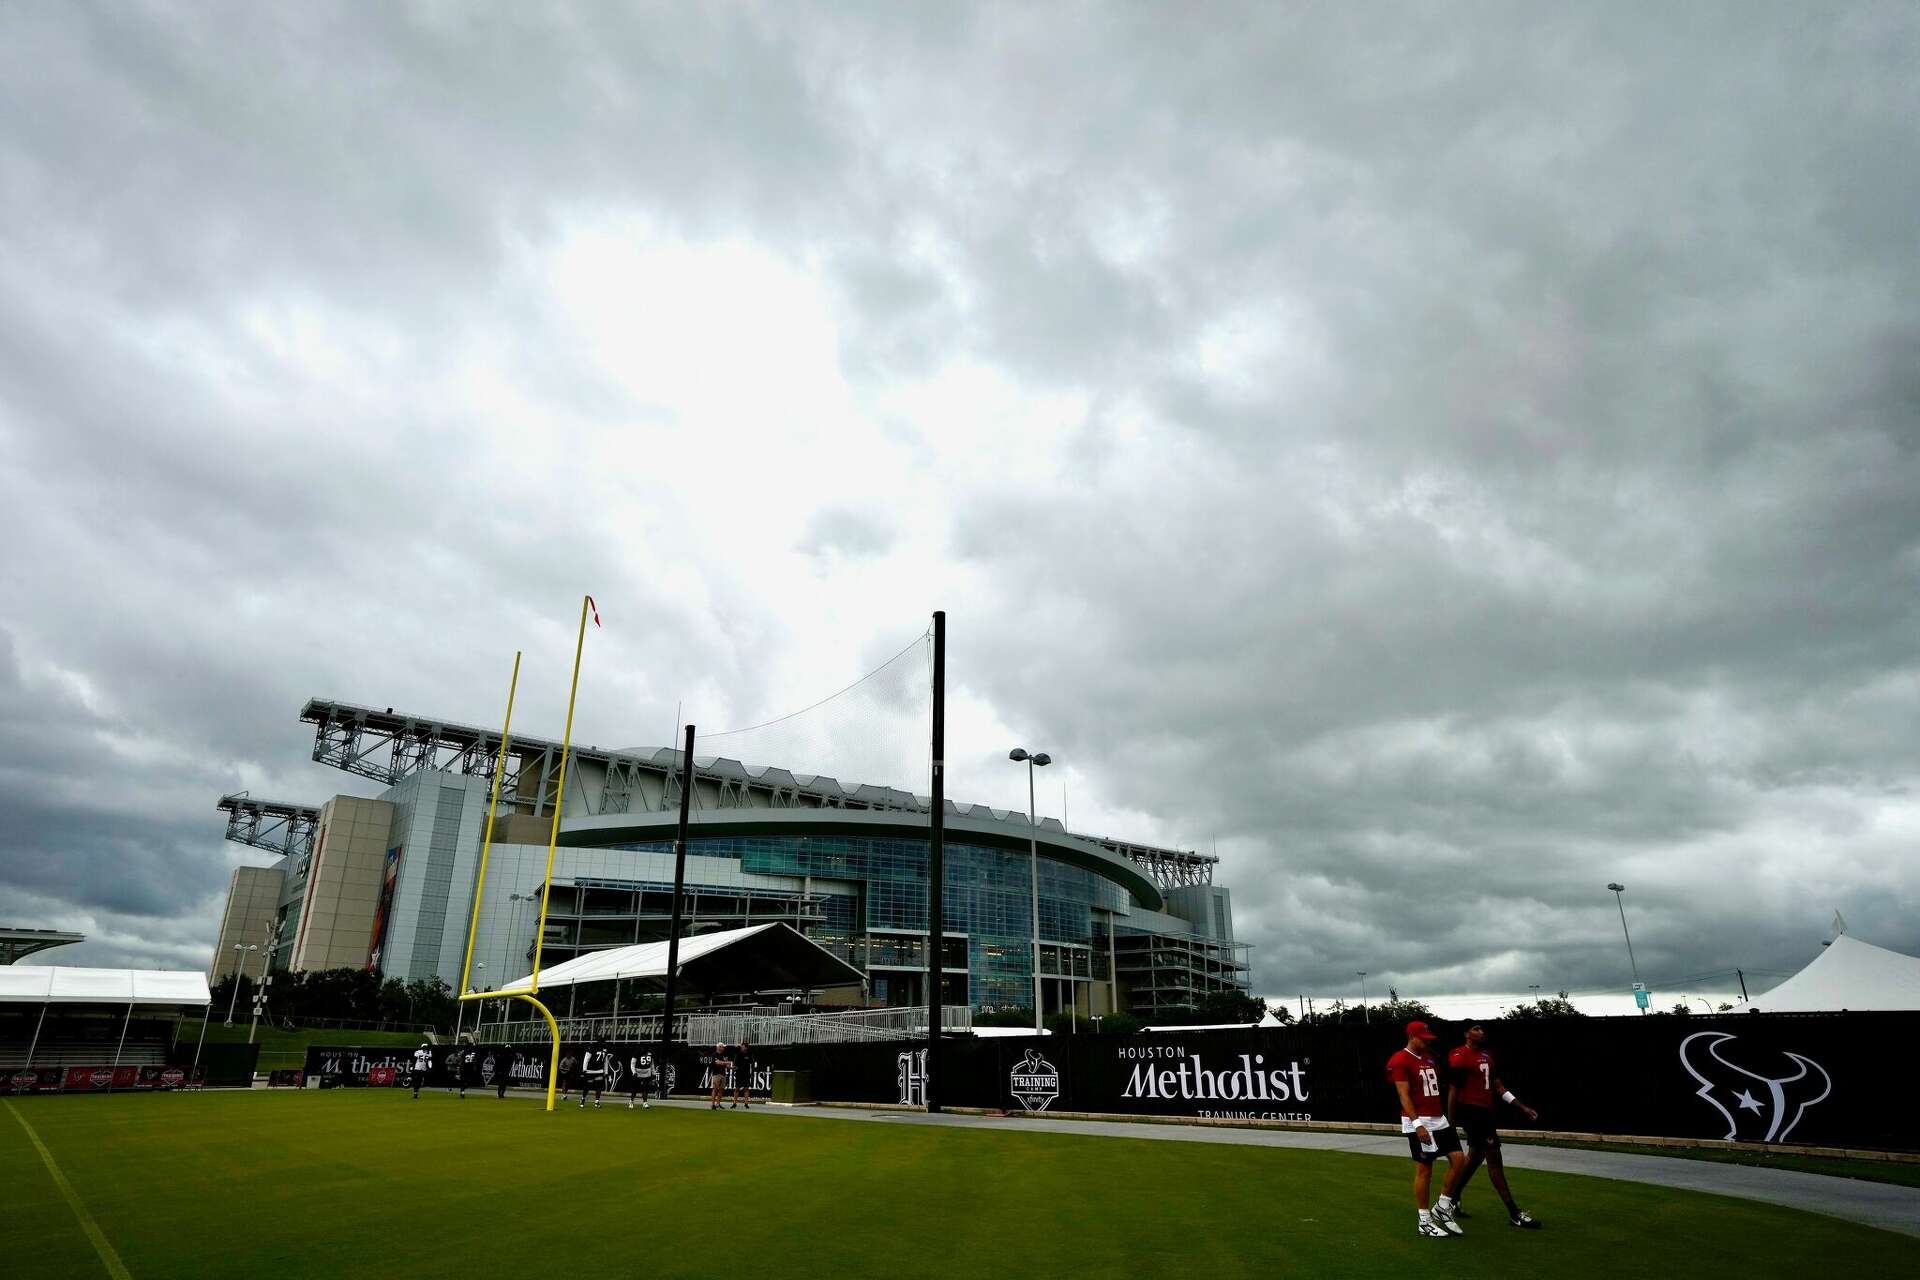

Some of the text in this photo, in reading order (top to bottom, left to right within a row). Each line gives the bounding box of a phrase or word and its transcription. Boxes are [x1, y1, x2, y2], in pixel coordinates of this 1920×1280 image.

[1118, 1046, 1185, 1060] HOUSTON
[1013, 1077, 1057, 1087] TRAINING
[1120, 1054, 1309, 1102] Methodist
[1418, 1068, 1440, 1097] 18
[1479, 1062, 1490, 1090] 7
[1198, 1110, 1256, 1121] TRAINING
